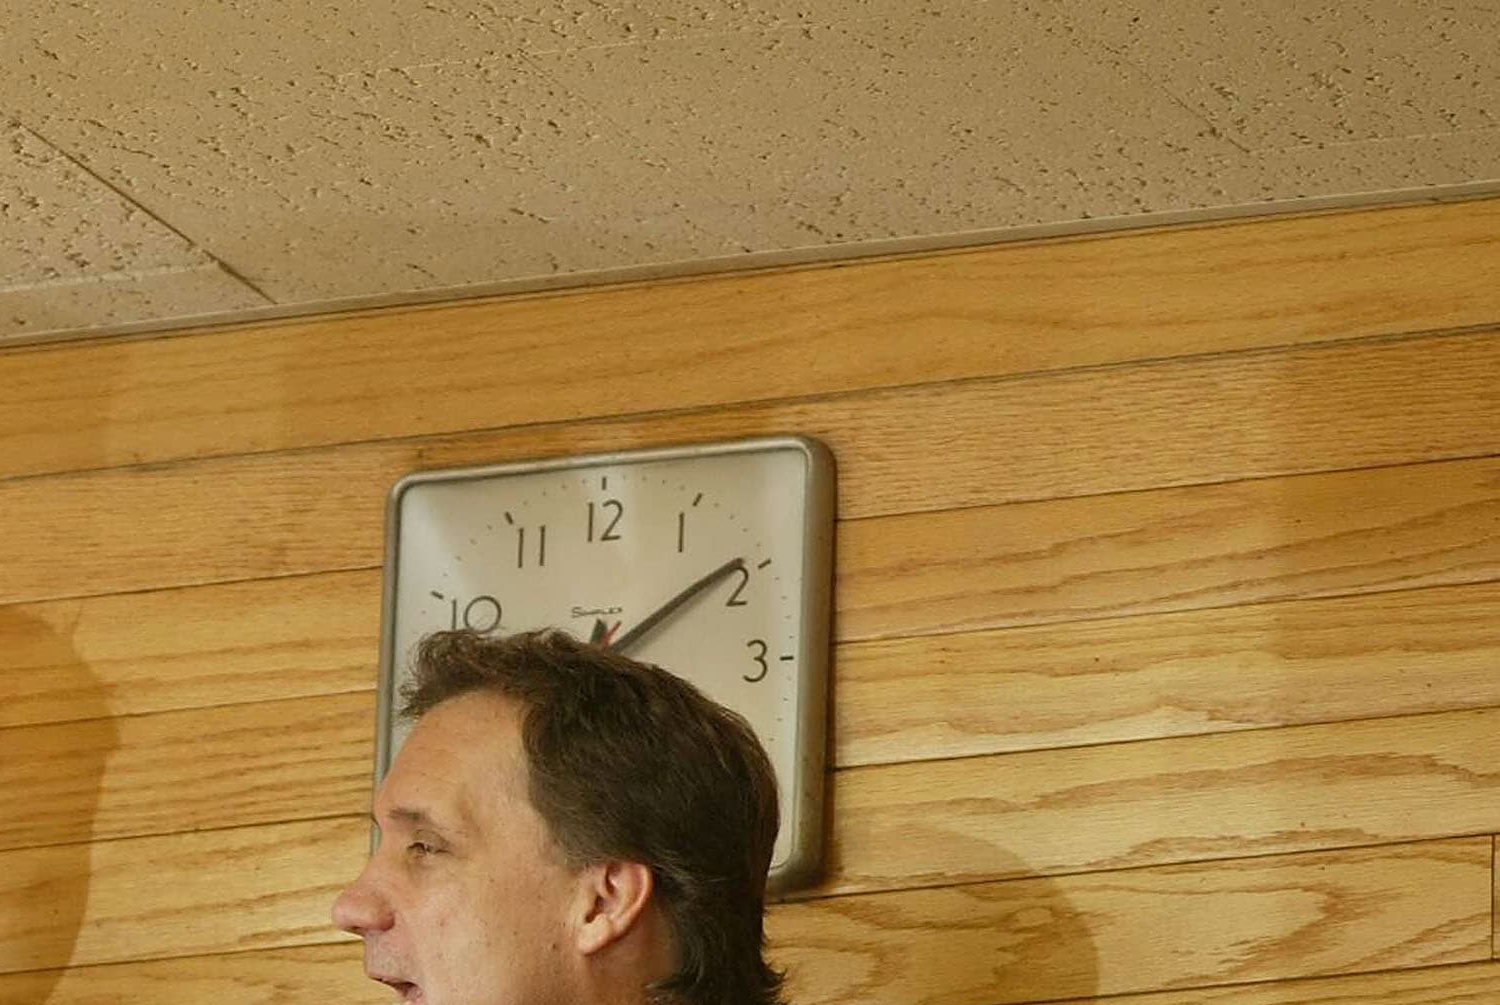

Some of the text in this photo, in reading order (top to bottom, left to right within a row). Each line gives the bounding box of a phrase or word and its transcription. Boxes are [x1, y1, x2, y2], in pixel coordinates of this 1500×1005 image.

[586, 499, 623, 543] 12
[517, 524, 547, 569] 11
[725, 565, 750, 607] 2
[451, 595, 502, 635] 10
[742, 639, 768, 683] 3
